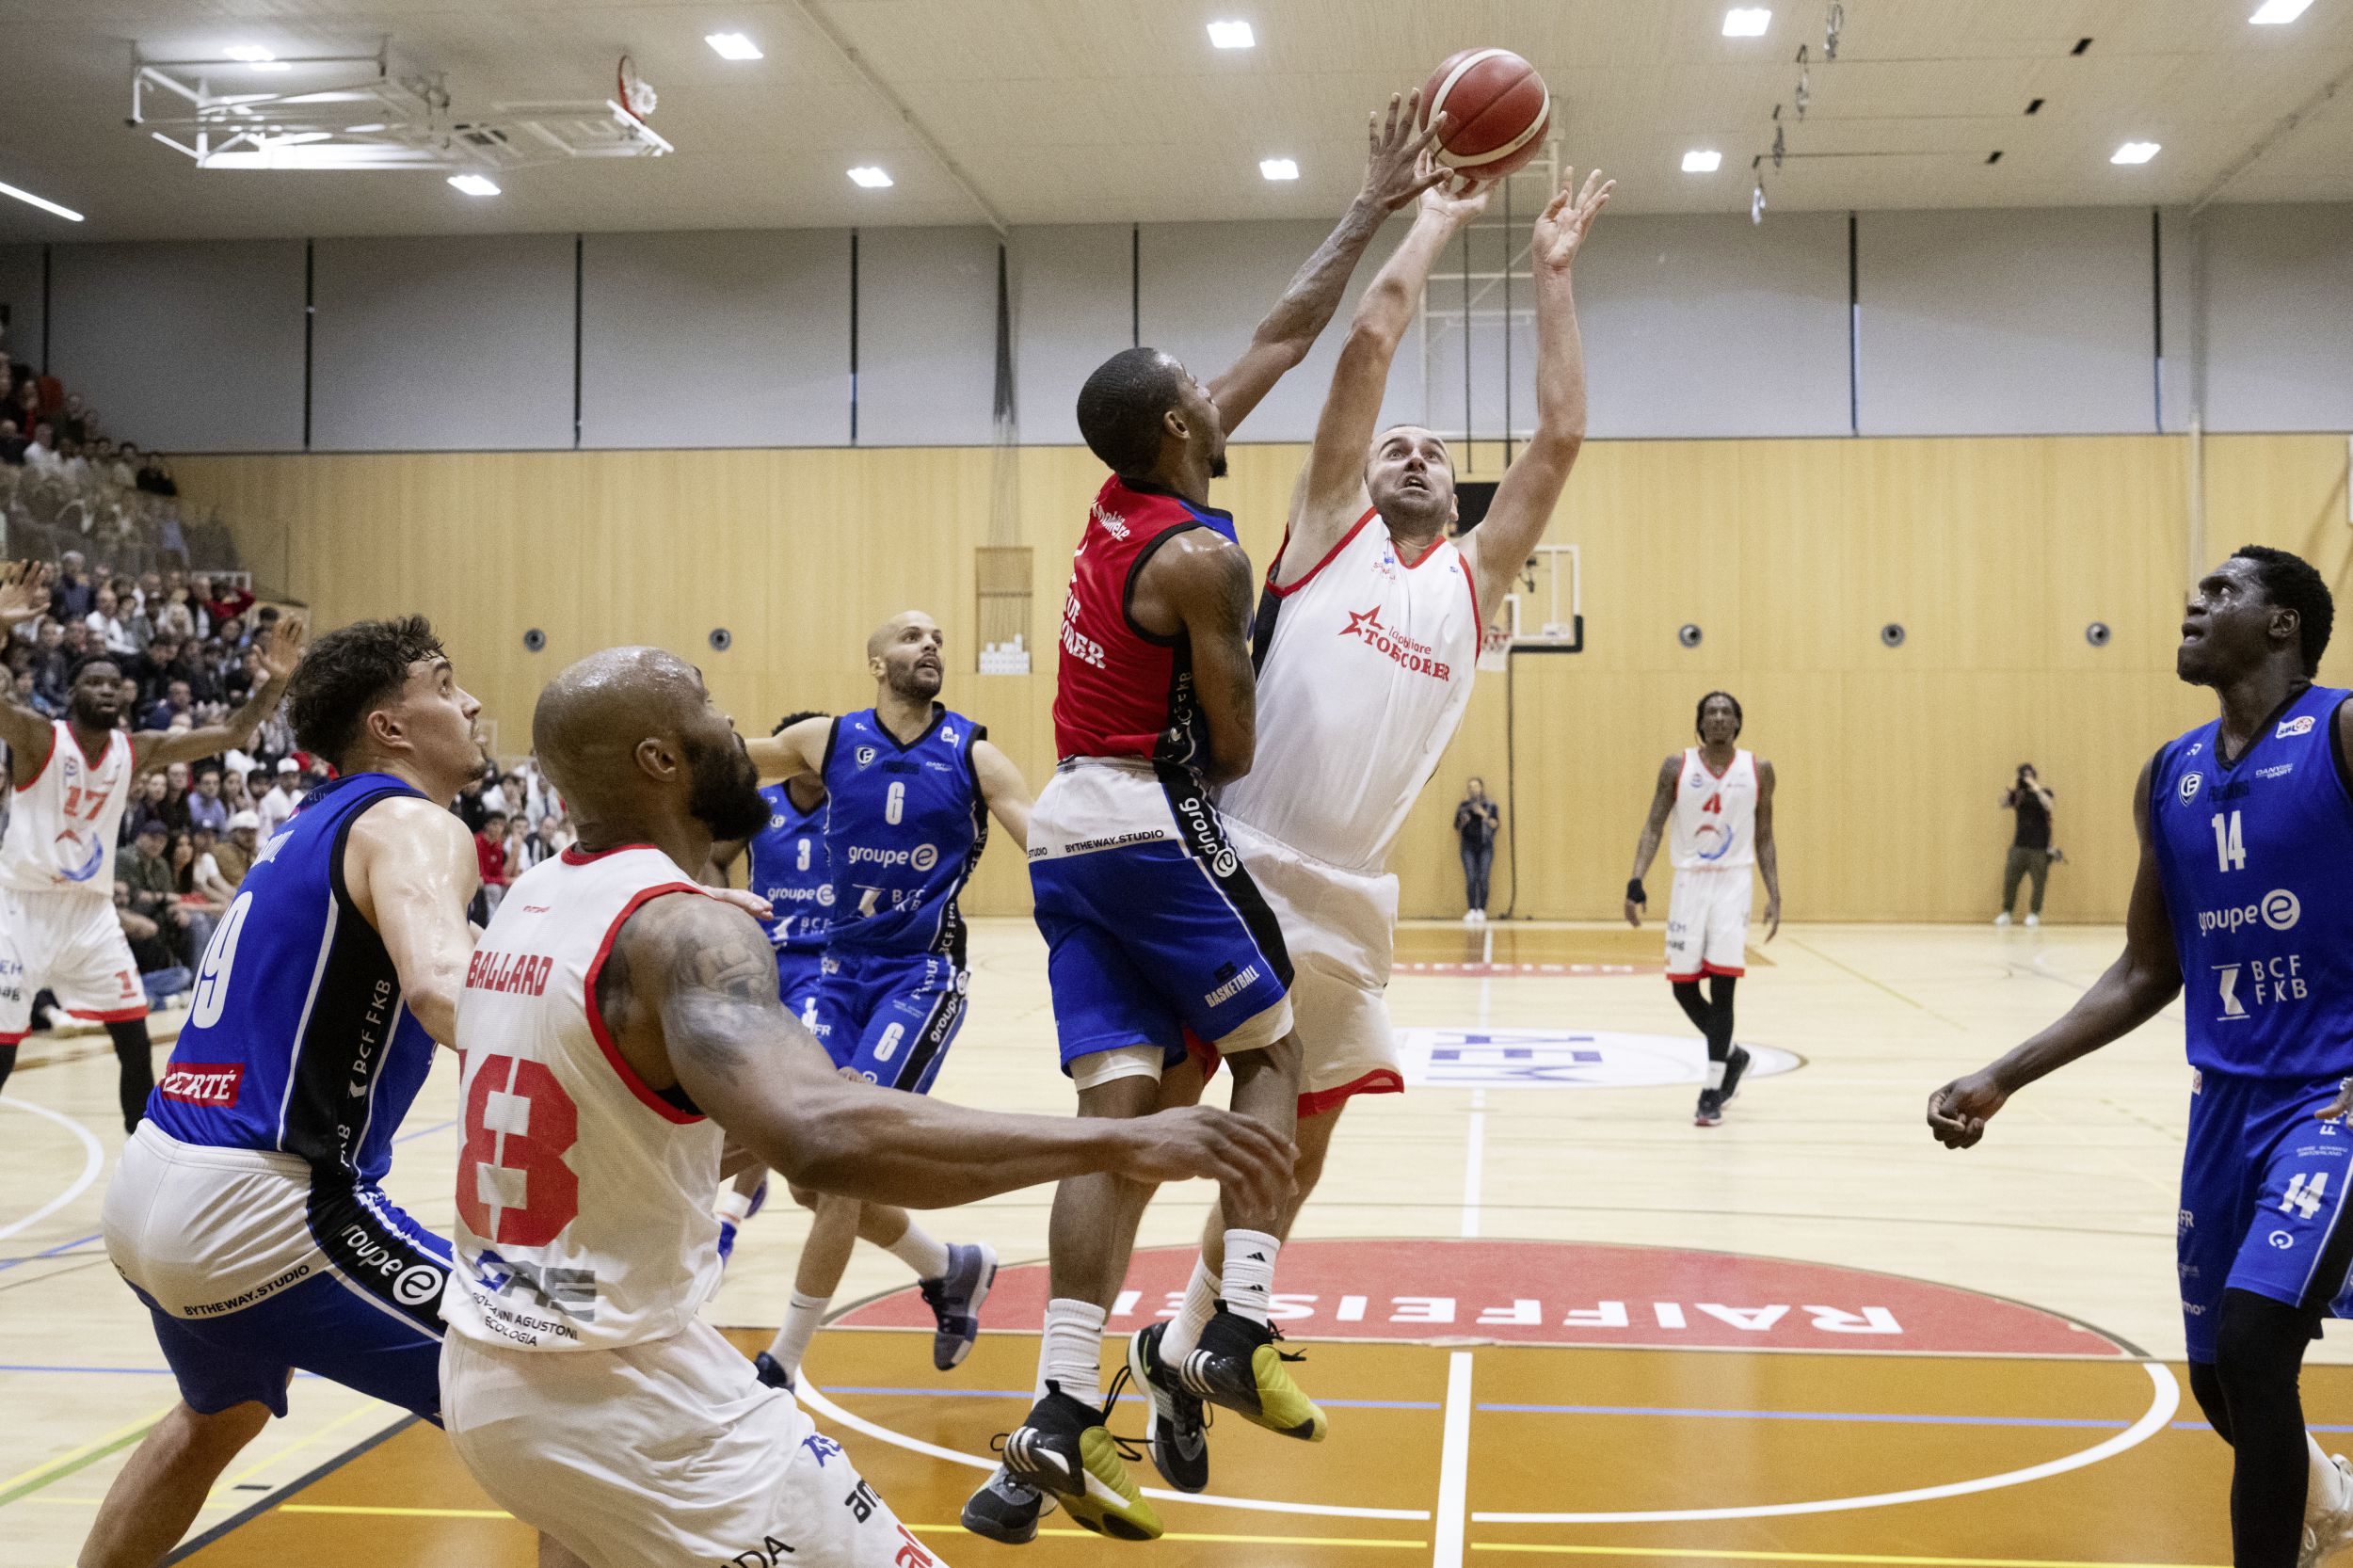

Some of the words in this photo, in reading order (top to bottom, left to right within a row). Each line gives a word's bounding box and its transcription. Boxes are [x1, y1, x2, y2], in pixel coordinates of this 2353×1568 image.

[63, 785, 109, 821] 17
[885, 781, 905, 825] 6
[1702, 792, 1721, 815] 4
[796, 838, 811, 872] 3
[848, 845, 909, 869] groupe
[1064, 829, 1164, 854] BYTHEWAY.STUDIO
[2212, 809, 2247, 872] 14
[767, 887, 816, 903] groupe
[2199, 904, 2258, 937] groupe
[184, 890, 253, 1029] 9
[465, 950, 553, 997] BALLARD
[2251, 954, 2301, 982] BCF
[1205, 965, 1260, 1008] BASKETBALL
[2255, 978, 2308, 1005] FKB
[873, 1022, 905, 1063] 6
[456, 1048, 580, 1248] 8
[2279, 1172, 2329, 1220] 14
[184, 1264, 310, 1317] BYTHEWAY.STUDIO
[485, 1316, 537, 1347] ECOLOGIA
[515, 1314, 578, 1340] AGUSTONI
